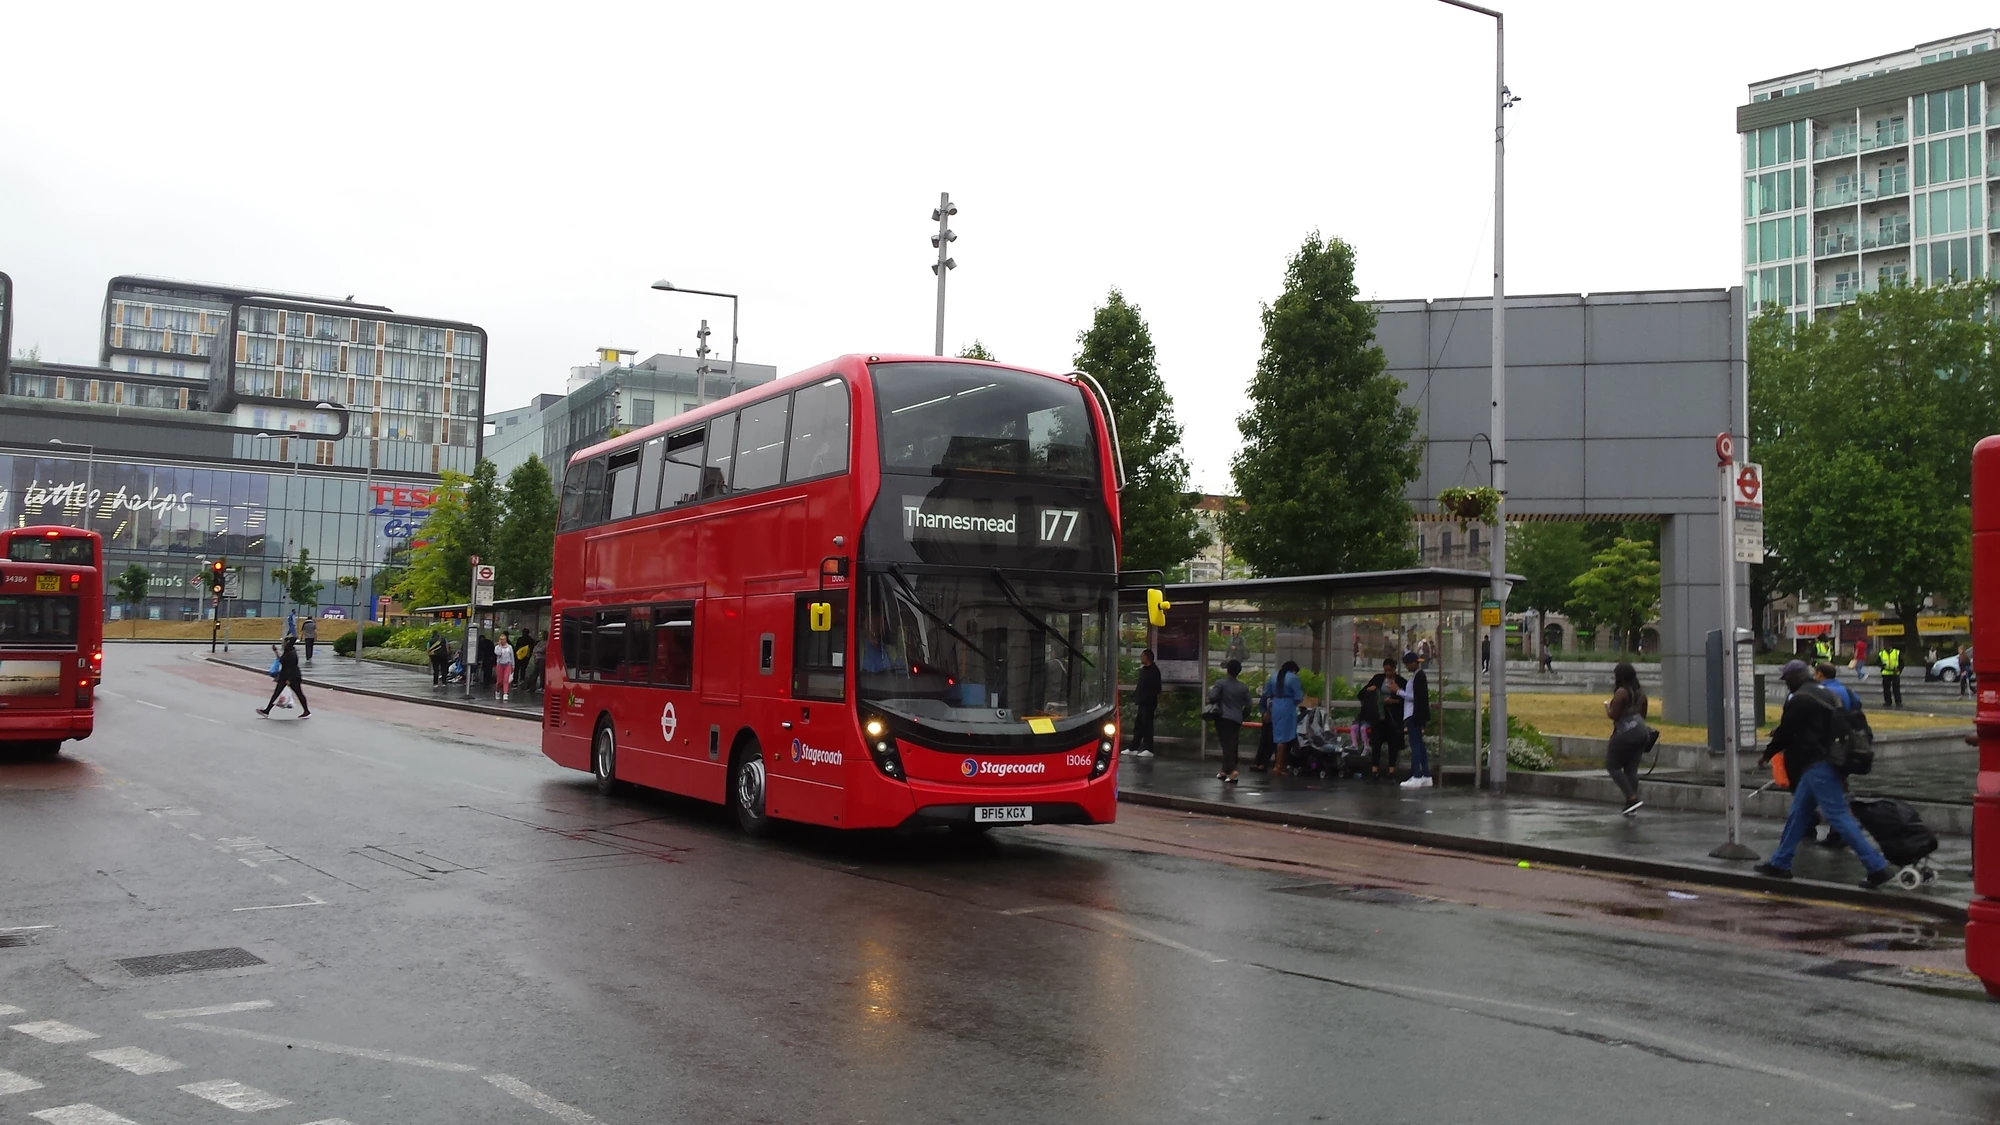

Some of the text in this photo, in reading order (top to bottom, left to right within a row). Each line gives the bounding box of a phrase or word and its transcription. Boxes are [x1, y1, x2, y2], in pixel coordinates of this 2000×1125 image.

[1721, 438, 1732, 456] Q
[112, 485, 194, 520] helps
[904, 506, 1079, 542] Thamesmead 177
[5, 575, 28, 583] 34384
[801, 743, 843, 766] Stagecoach
[1066, 754, 1092, 766] 13066
[980, 761, 1045, 777] Stagecoach
[981, 808, 1026, 819] BF15 KGX
